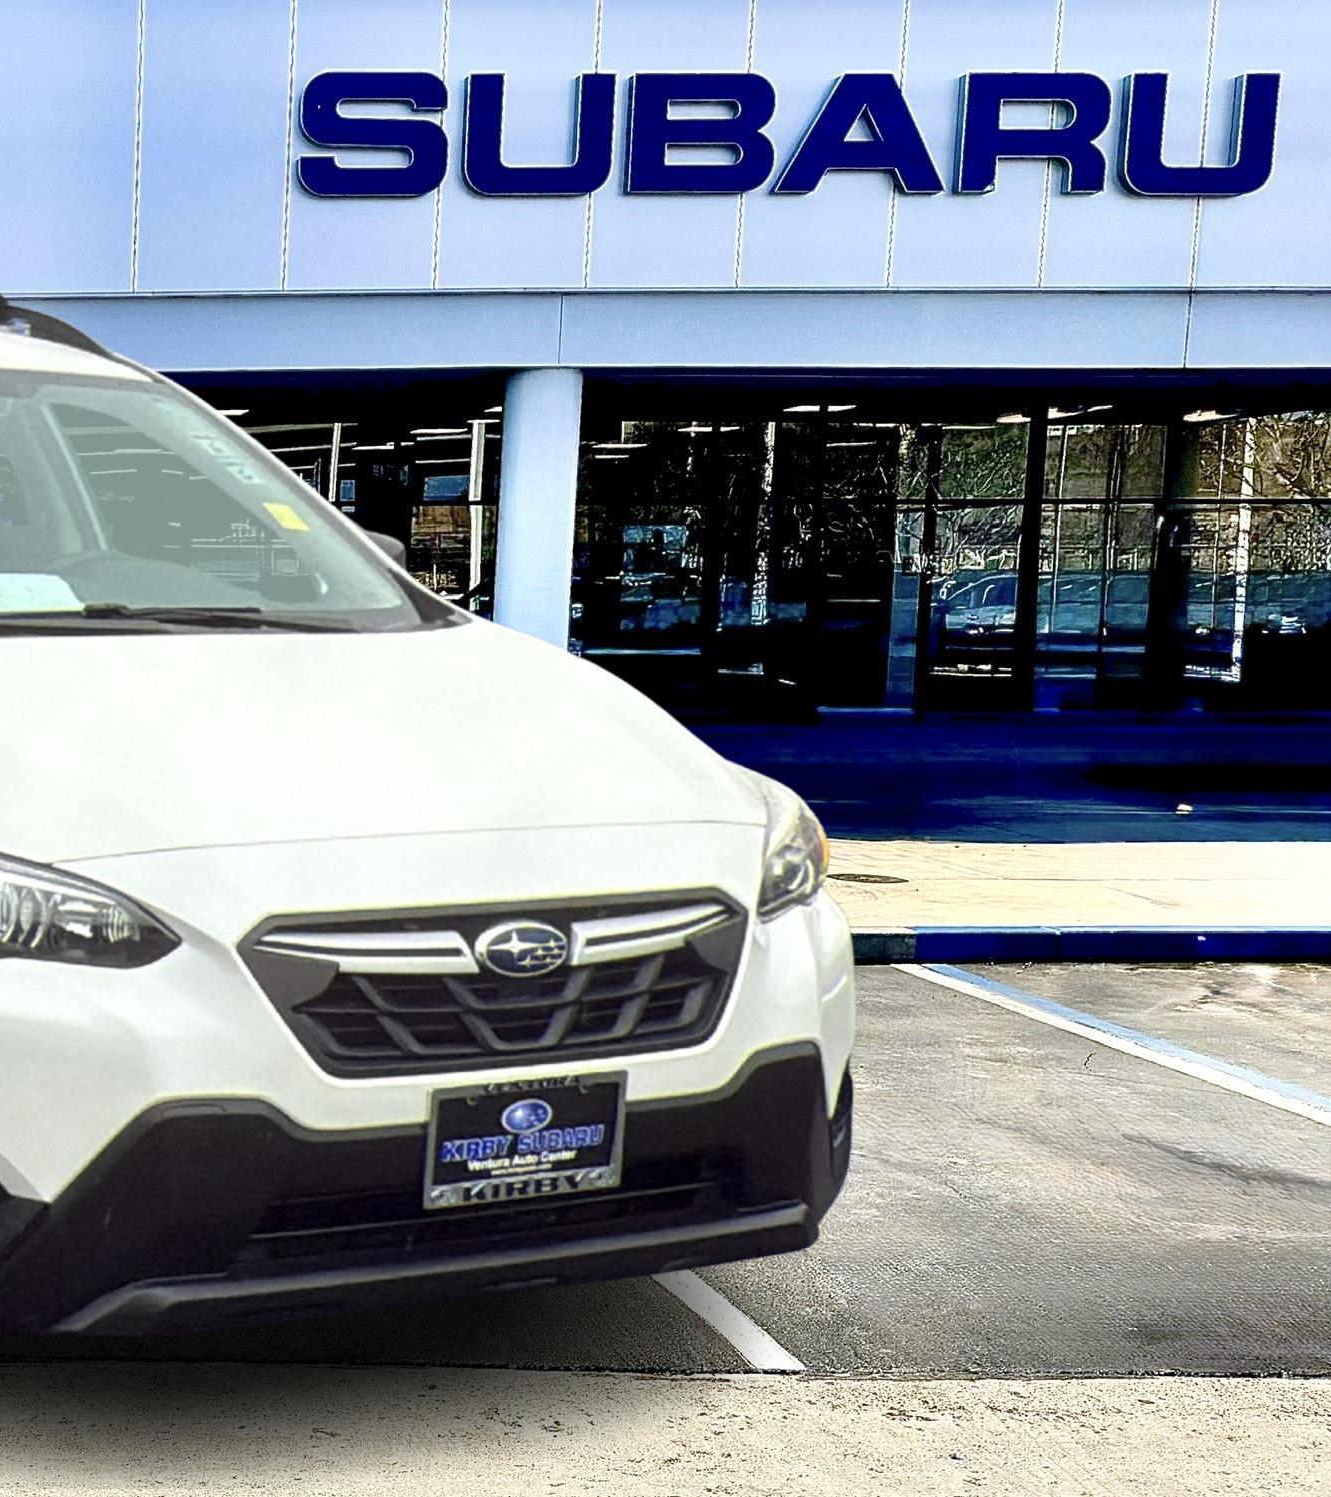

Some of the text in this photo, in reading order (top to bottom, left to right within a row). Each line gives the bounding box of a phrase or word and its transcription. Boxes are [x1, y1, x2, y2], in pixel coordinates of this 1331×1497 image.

[296, 70, 1281, 198] SUBARU
[441, 1124, 605, 1163] KIRBY SUBARU
[467, 1157, 510, 1172] Ventura
[511, 1153, 539, 1167] Auto
[540, 1149, 578, 1163] Center
[463, 1173, 583, 1201] KIRBY
